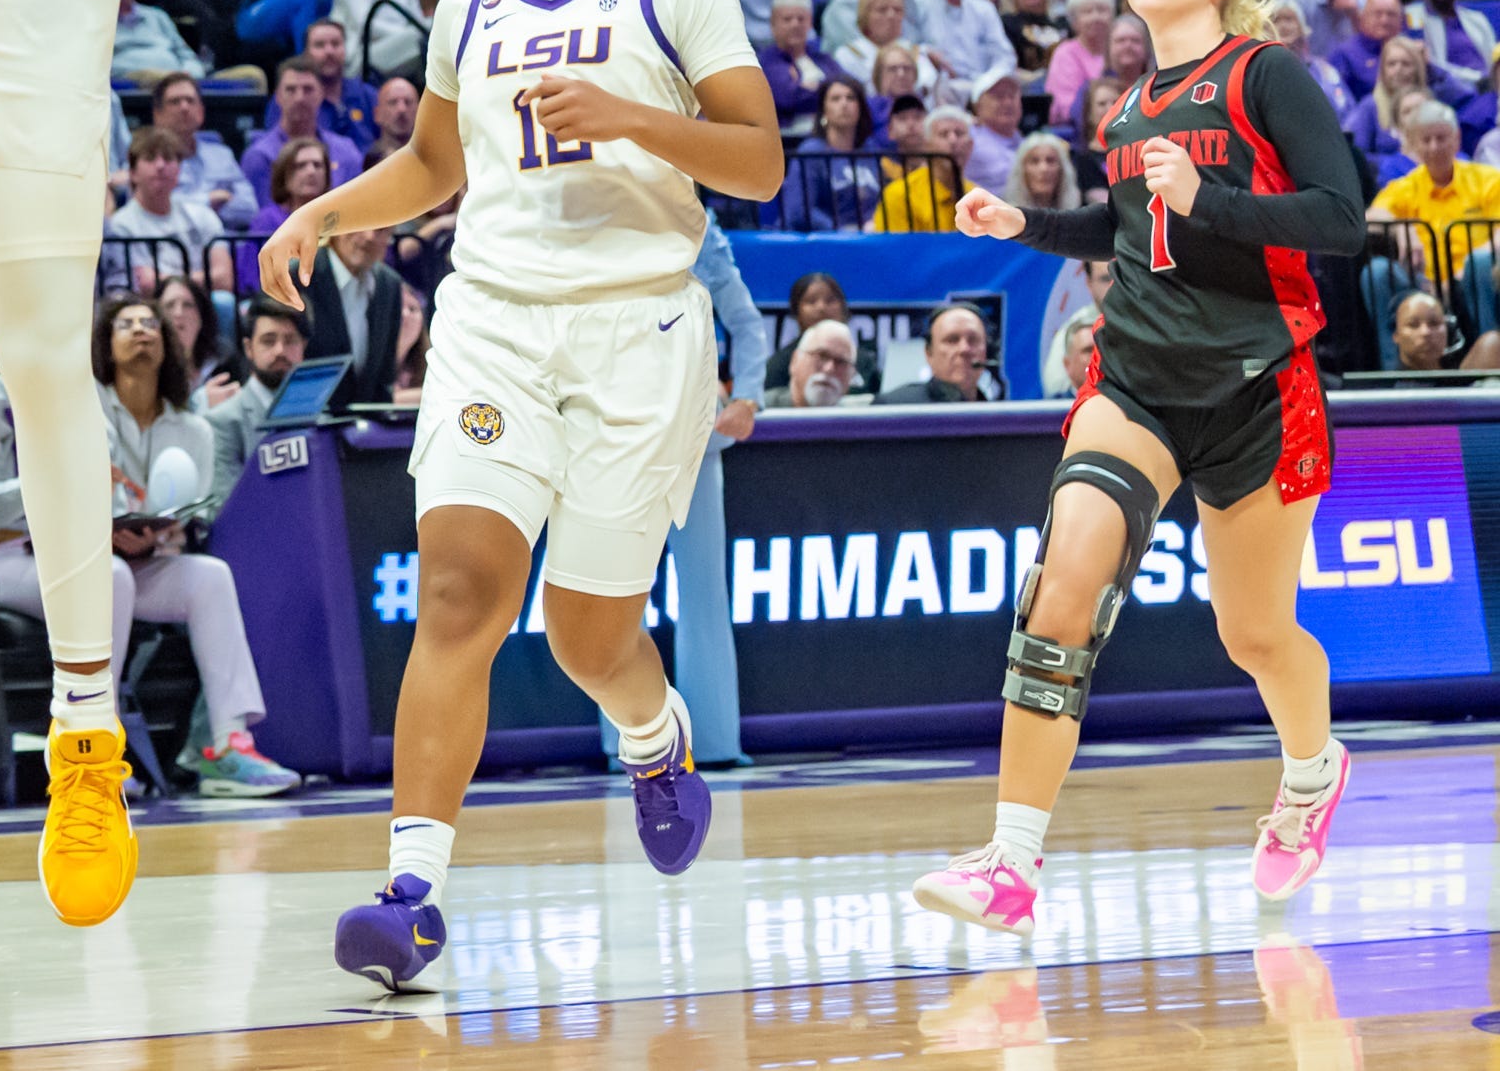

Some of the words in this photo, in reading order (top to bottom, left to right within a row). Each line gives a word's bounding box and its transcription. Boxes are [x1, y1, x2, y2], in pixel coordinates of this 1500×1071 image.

[486, 26, 612, 78] LSU
[1147, 193, 1177, 272] 1
[1300, 518, 1453, 589] LSU
